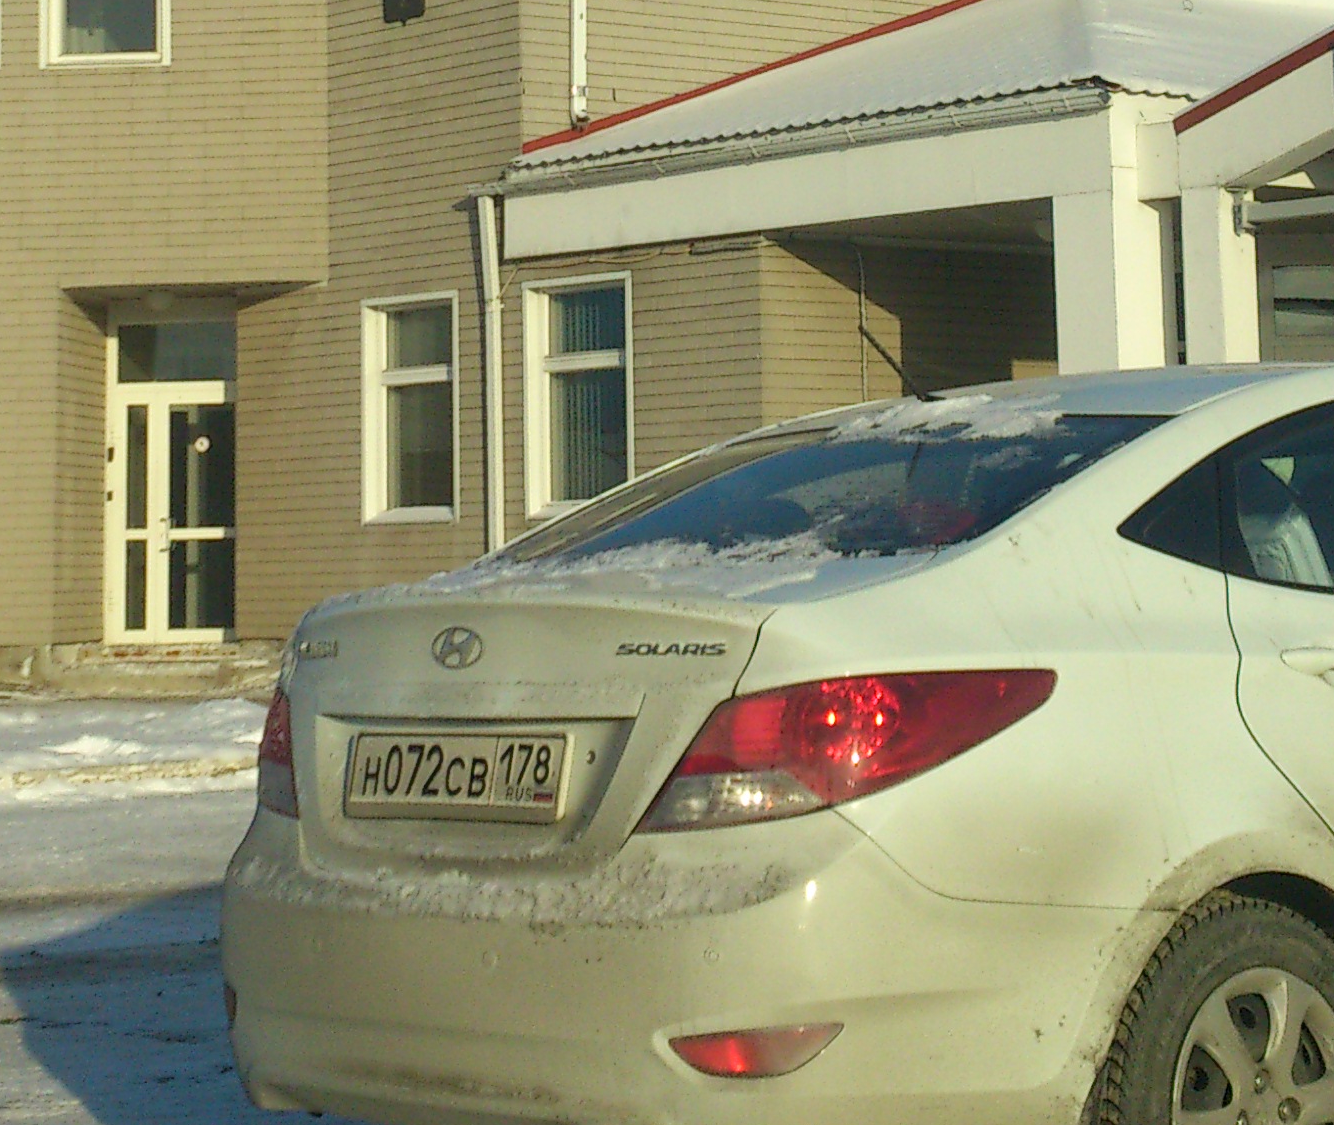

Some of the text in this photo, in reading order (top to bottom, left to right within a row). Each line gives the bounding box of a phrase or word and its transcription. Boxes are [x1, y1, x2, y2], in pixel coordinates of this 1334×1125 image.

[615, 642, 727, 656] SOLARIS
[499, 743, 552, 786] 178
[505, 786, 533, 802] RUS
